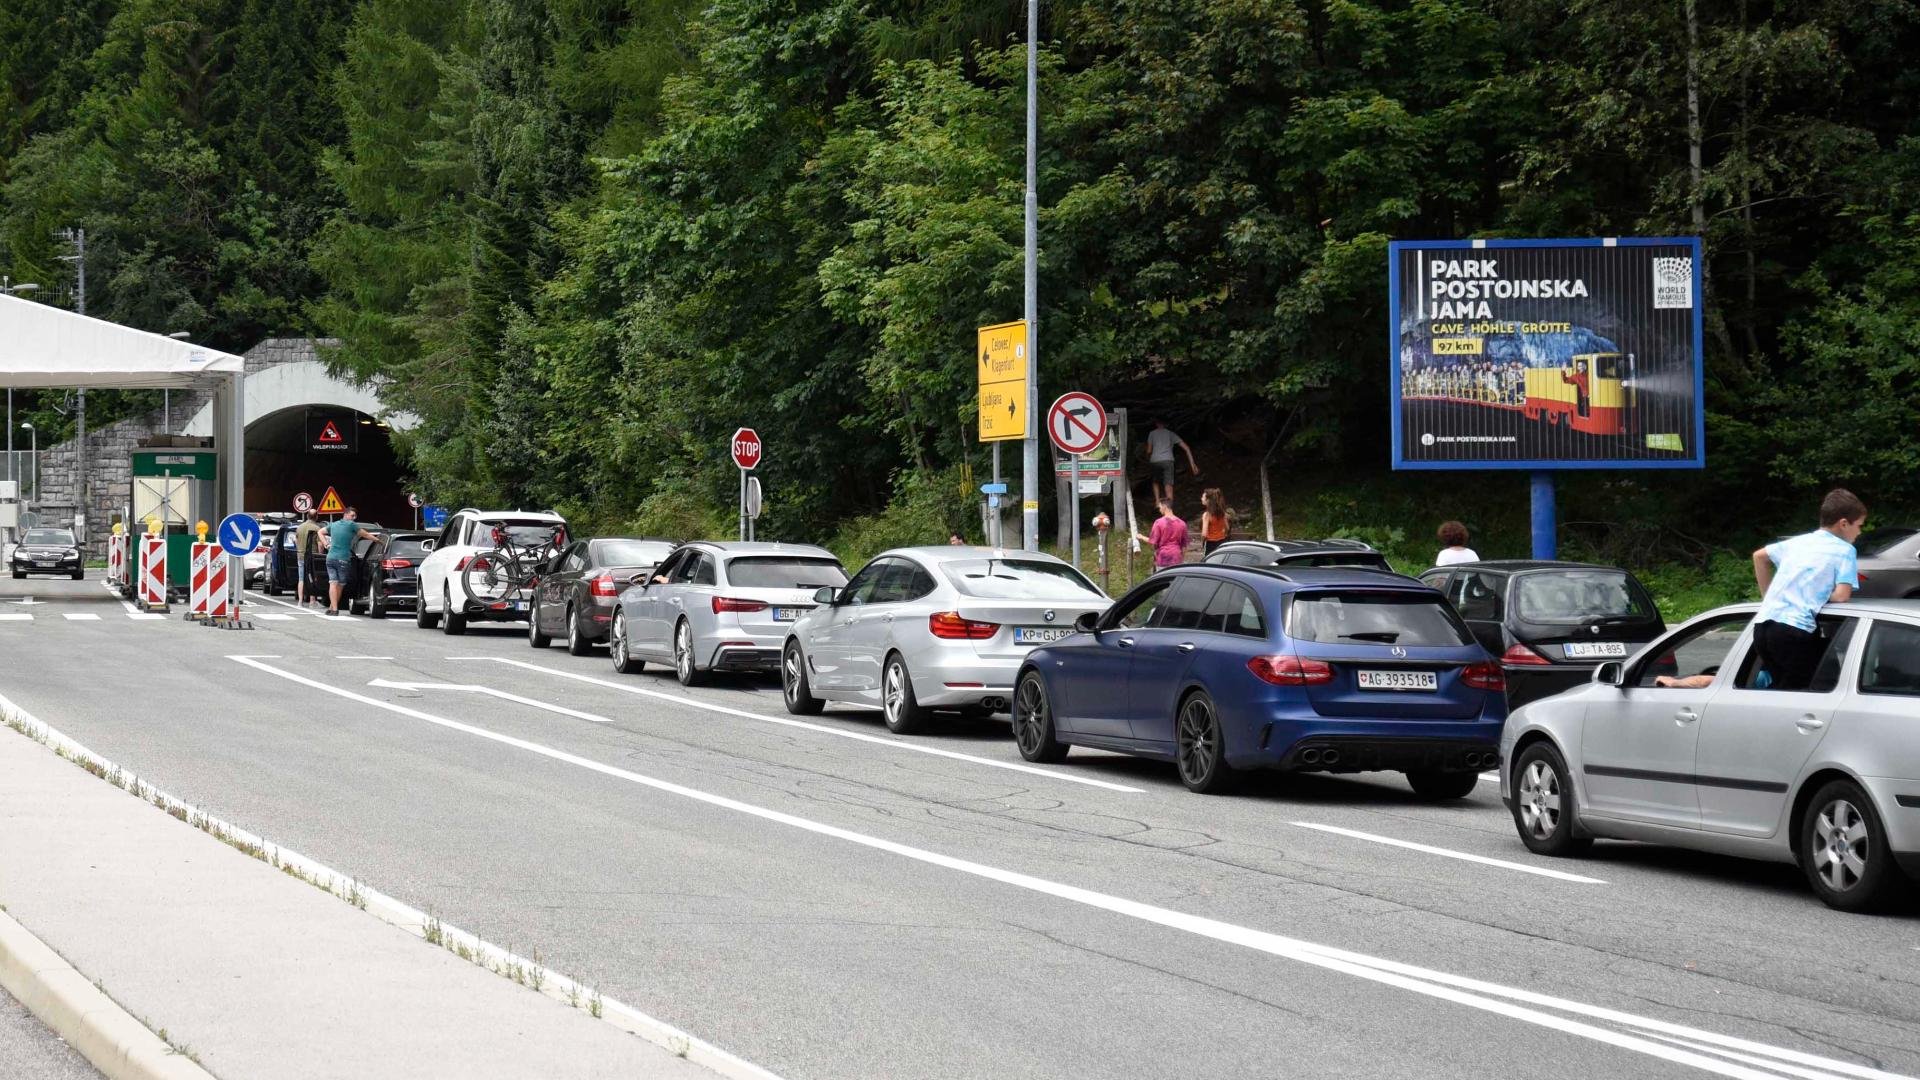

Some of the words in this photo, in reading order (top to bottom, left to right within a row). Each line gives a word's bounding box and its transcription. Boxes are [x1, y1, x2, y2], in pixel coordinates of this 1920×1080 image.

[1431, 259, 1498, 279] PARK
[1431, 279, 1589, 299] POSTOJNSKA
[1430, 300, 1493, 320] JAMA
[1431, 323, 1464, 334] CAVE
[1471, 321, 1515, 334] HÖHLE
[1521, 322, 1572, 333] GROTTE
[1438, 342, 1452, 352] 97
[1455, 340, 1474, 351] km
[735, 441, 759, 457] STOP
[1022, 630, 1036, 641] KP
[1573, 645, 1585, 655] LJ
